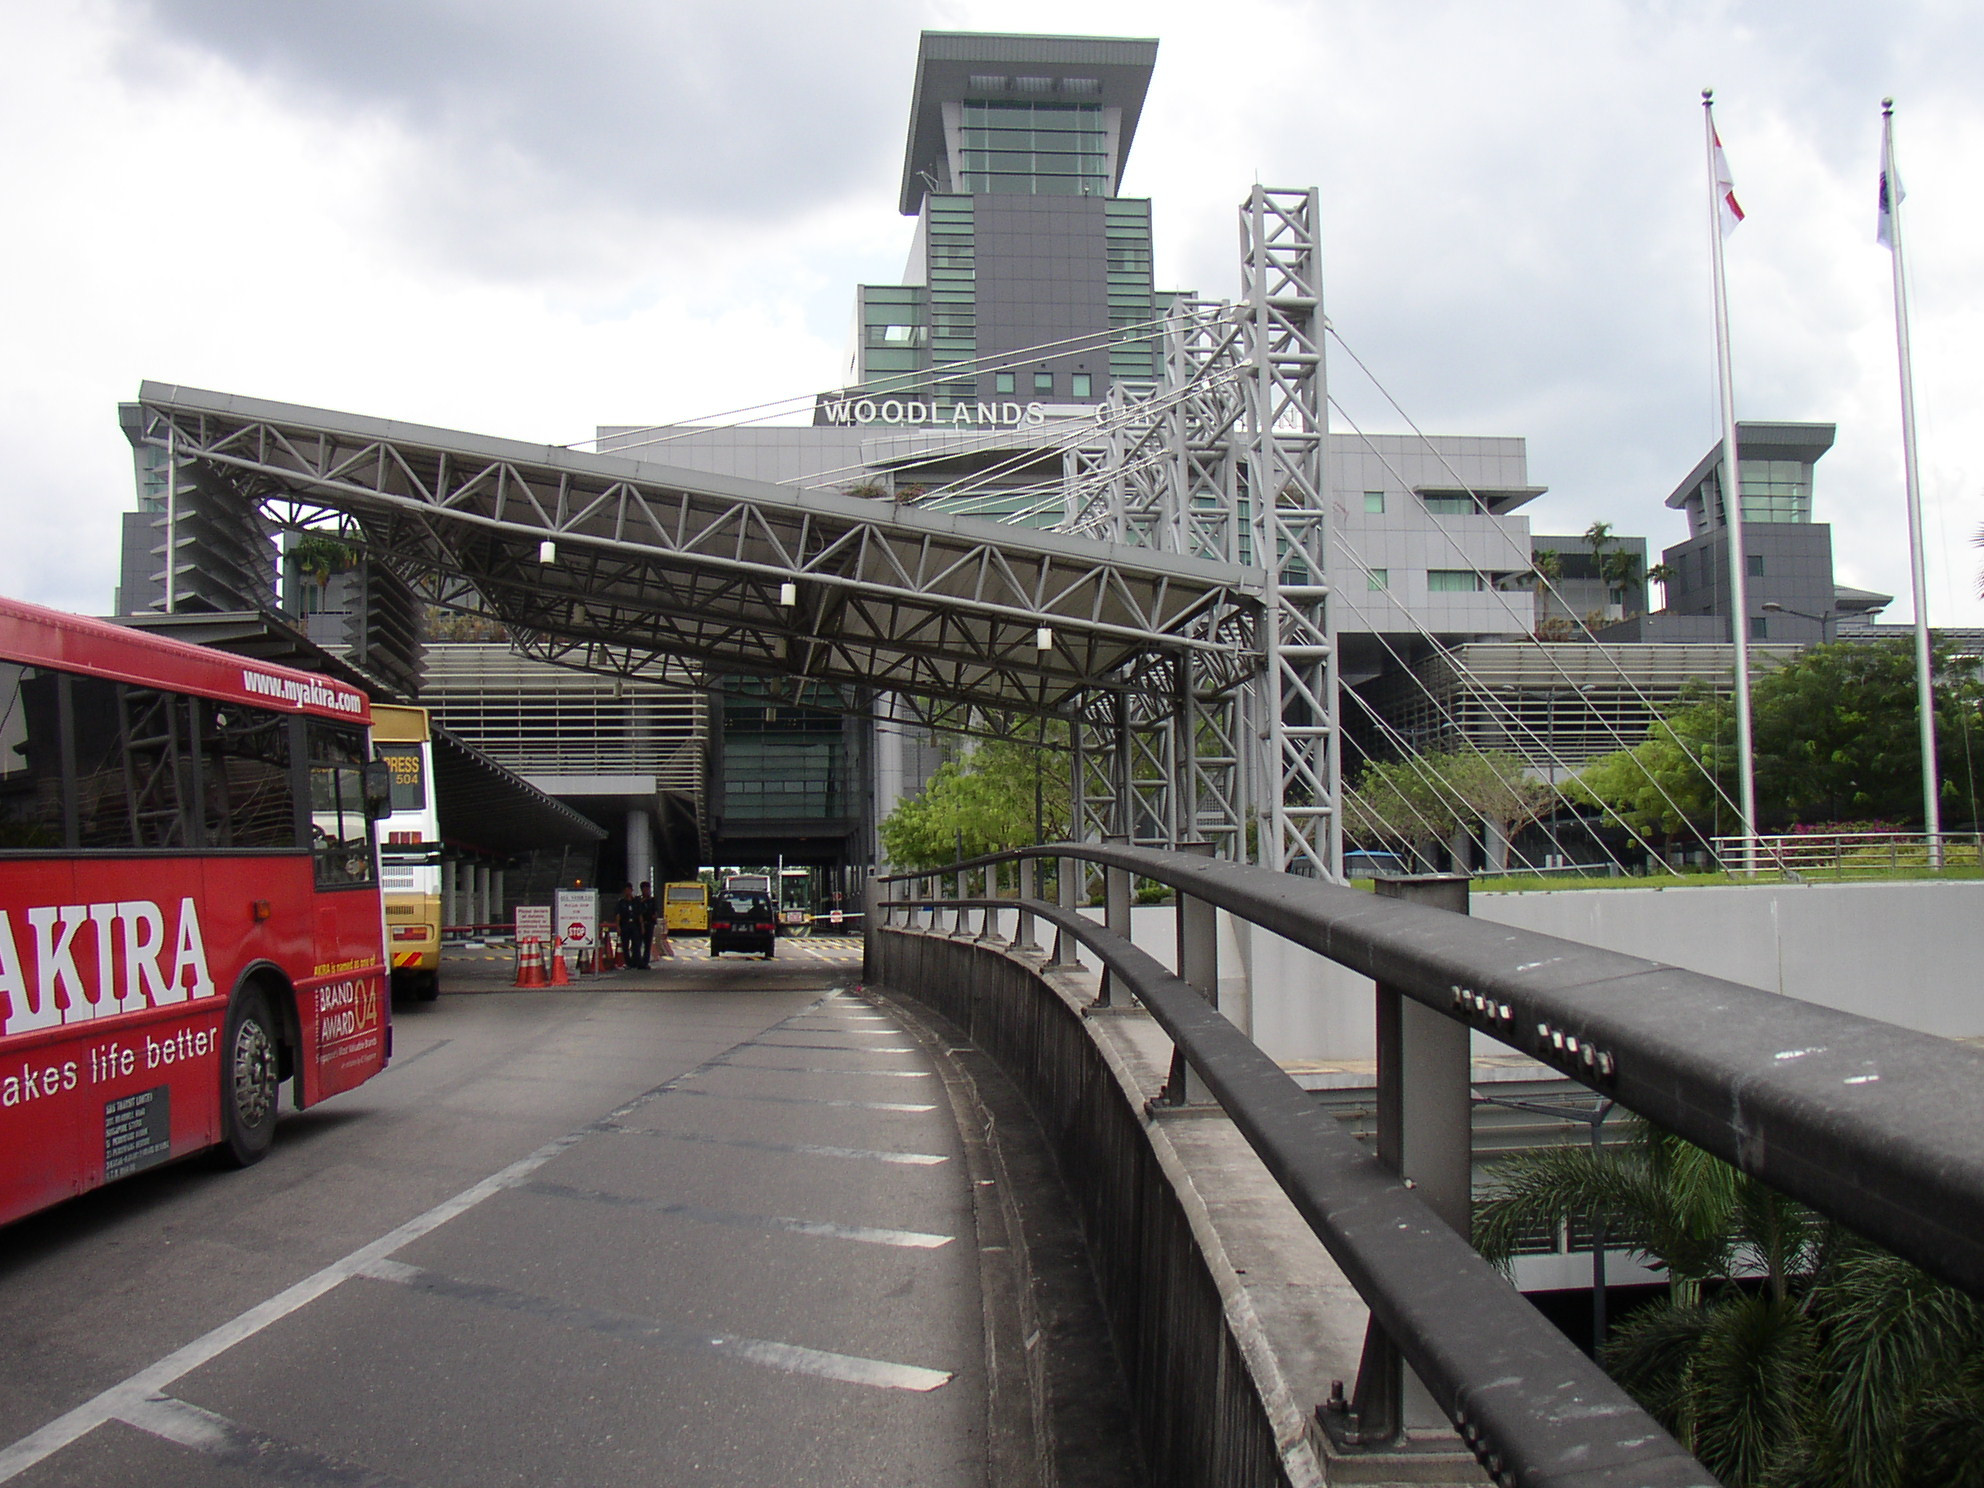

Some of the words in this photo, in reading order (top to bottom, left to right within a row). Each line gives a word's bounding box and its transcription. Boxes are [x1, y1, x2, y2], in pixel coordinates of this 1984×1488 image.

[823, 400, 1046, 425] WOODLANDS
[243, 670, 362, 714] www.myakira.com
[396, 773, 419, 785] 504
[568, 927, 585, 937] STOP
[320, 981, 354, 1013] BRAND
[355, 976, 378, 1030] 04
[321, 1010, 355, 1042] AWARD
[92, 1042, 135, 1084] life
[147, 1026, 218, 1070] better
